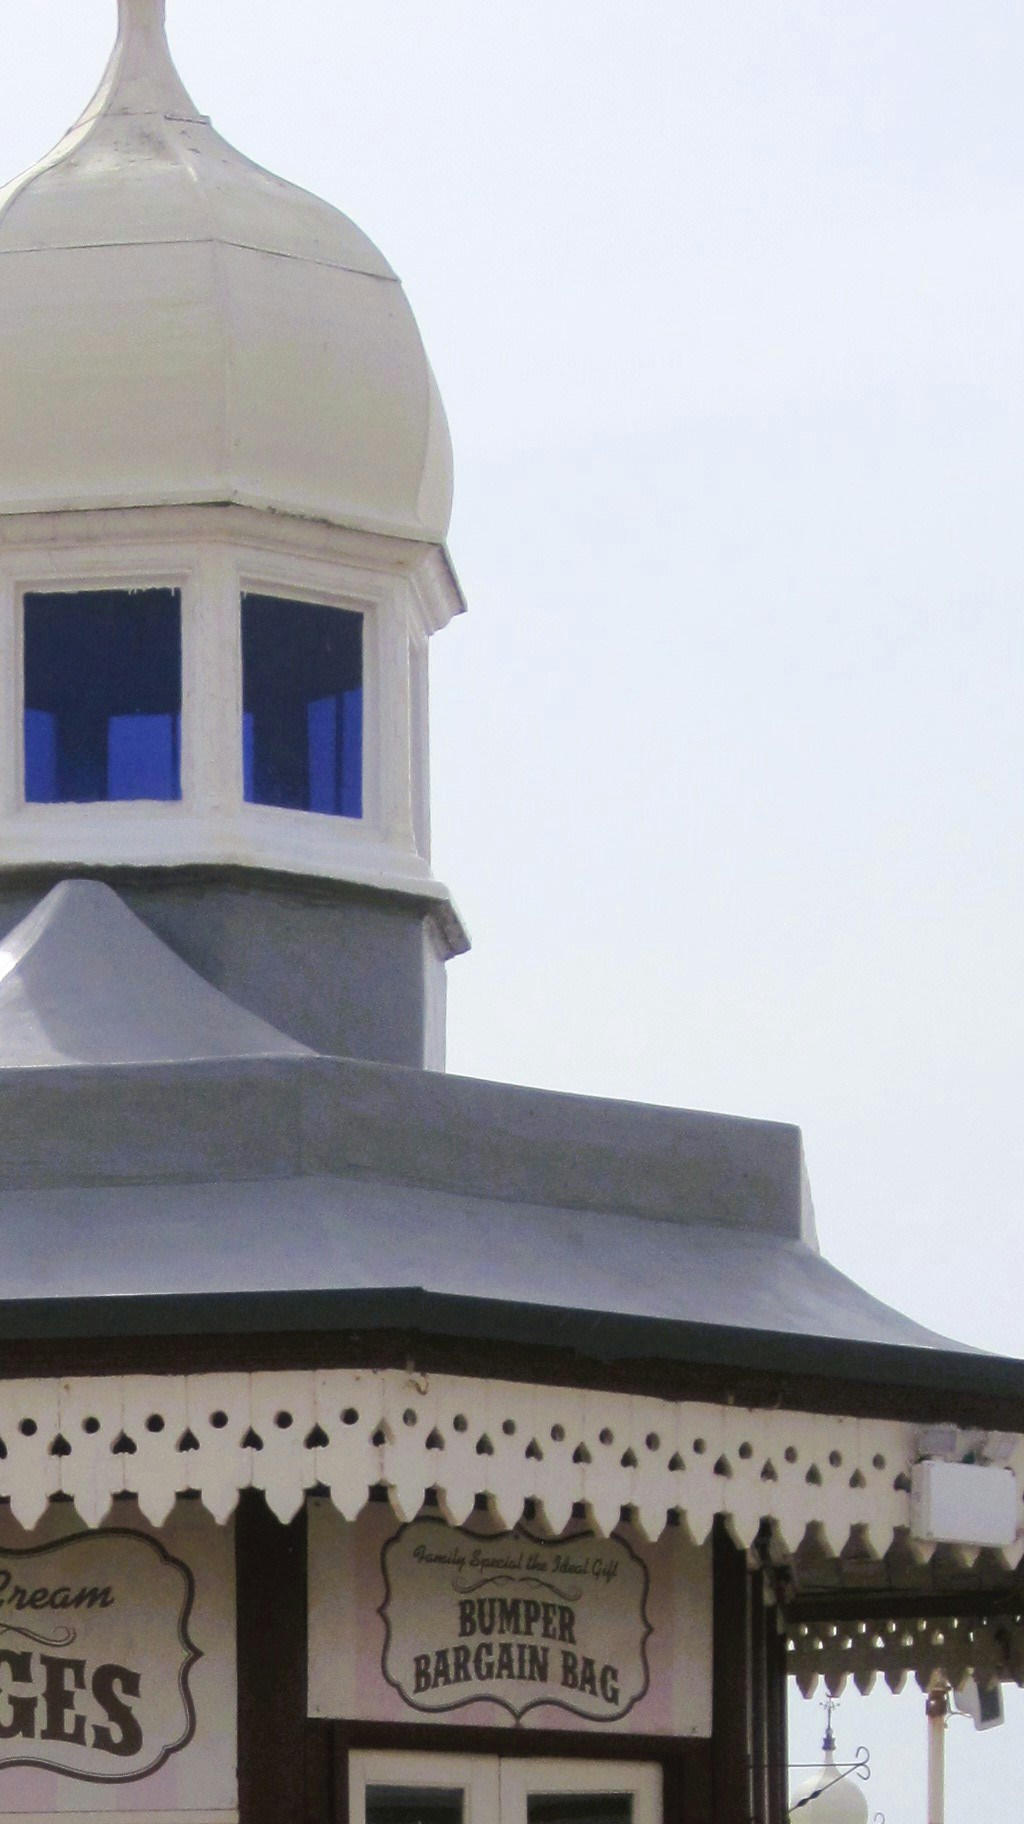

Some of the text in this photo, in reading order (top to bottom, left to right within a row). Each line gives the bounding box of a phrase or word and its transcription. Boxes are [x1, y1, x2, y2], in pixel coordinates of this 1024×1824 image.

[413, 1544, 620, 1583] Family Special the Ideal Gift
[458, 1598, 576, 1646] BUMPER
[413, 1641, 621, 1706] BARGAIN BAG
